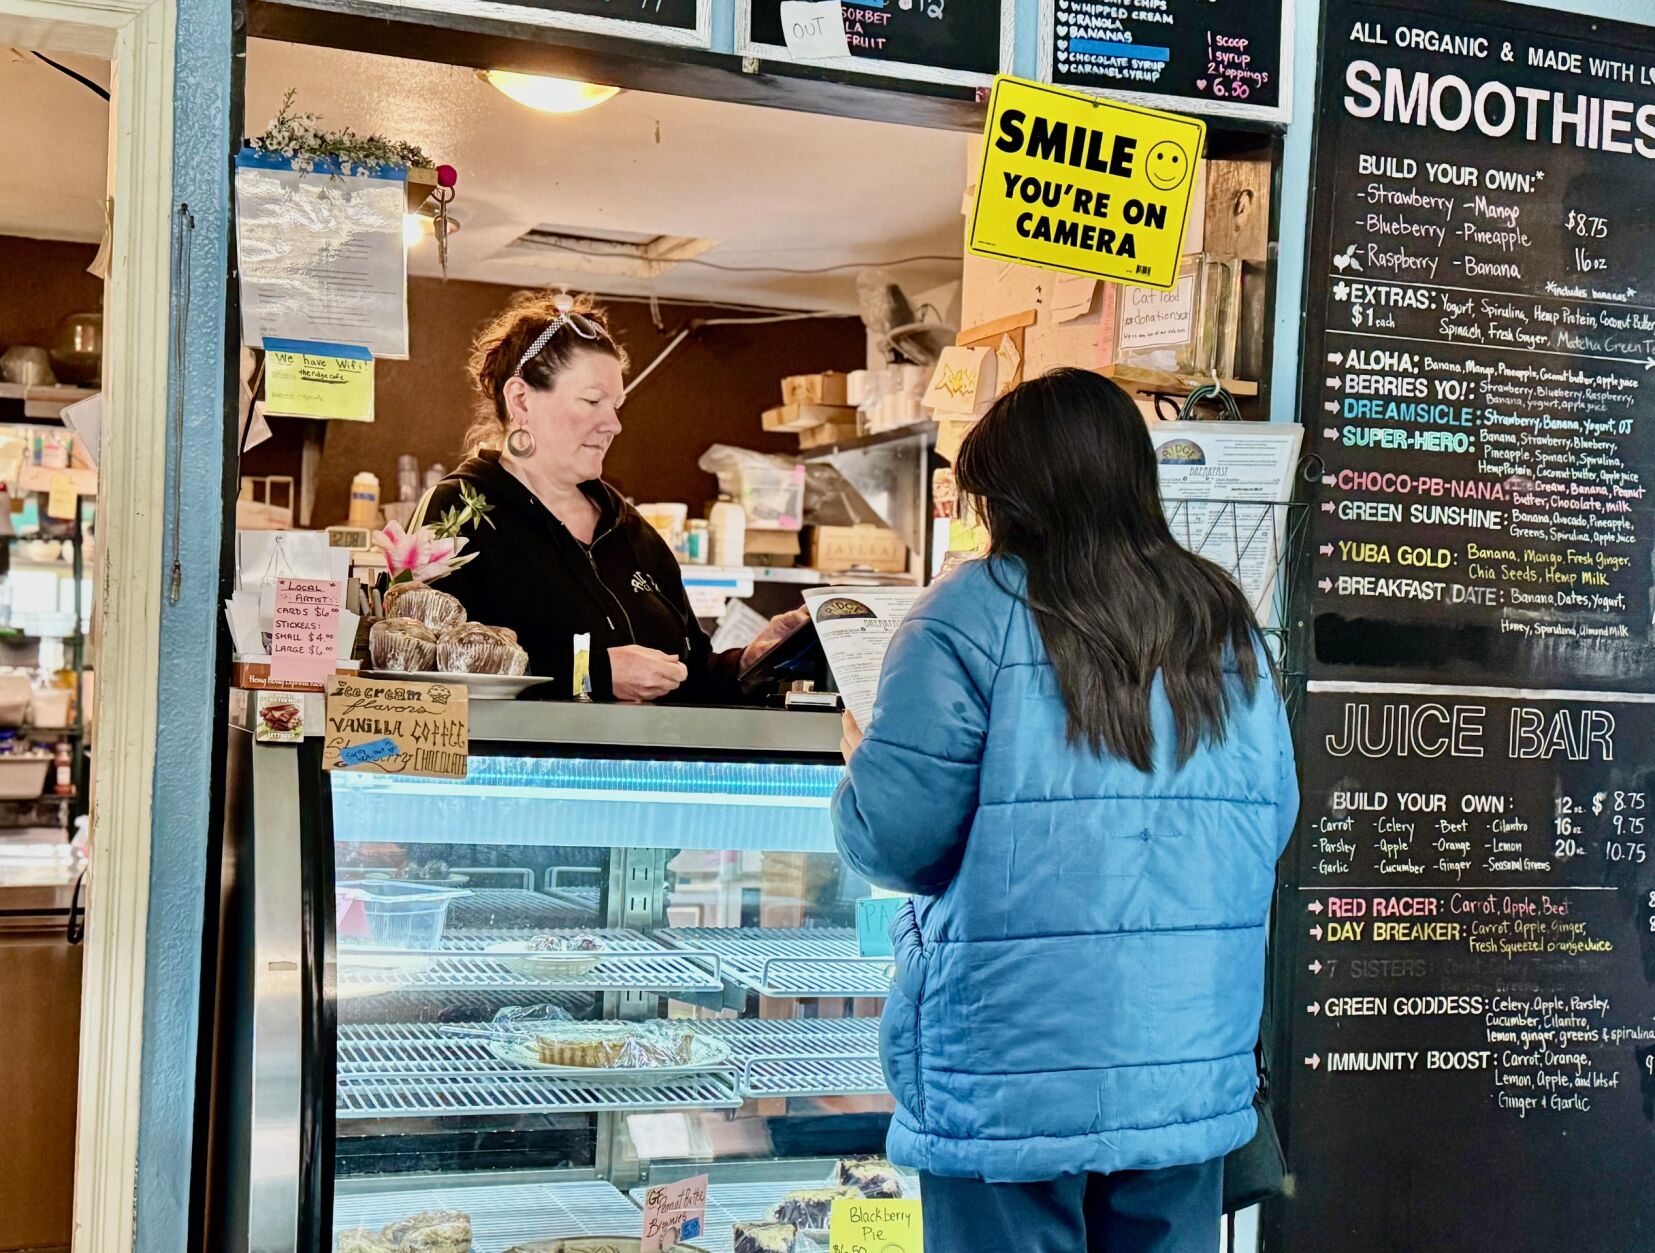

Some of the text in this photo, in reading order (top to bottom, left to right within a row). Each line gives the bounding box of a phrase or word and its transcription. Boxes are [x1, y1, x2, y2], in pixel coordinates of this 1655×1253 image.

[841, 7, 892, 26] SORBET
[1069, 13, 1123, 30] GRANOLA
[1071, 2, 1128, 19] WHIPPED
[1132, 11, 1174, 25] CREAM
[792, 17, 825, 39] OUT
[1069, 25, 1133, 43] BANANAS
[846, 34, 887, 49] FRUIT
[1216, 34, 1249, 50] scoop
[1350, 22, 1633, 83] ALL ORGANIC & MADE WITH
[1069, 52, 1165, 72] CHOCOLATE SYRUP
[1215, 51, 1250, 66] syrup
[1070, 63, 1160, 83] CARAMEL SYRUP
[1219, 63, 1269, 88] toppings
[1213, 78, 1250, 99] 6.50
[1344, 60, 1655, 159] SMOOTHIES
[995, 109, 1137, 178] SMILE
[1359, 154, 1477, 187] BUILD YOUR
[1003, 172, 1167, 230] YOU'RE ON
[1016, 212, 1136, 259] CAMERA
[1565, 210, 1608, 239] $8.75
[1557, 332, 1601, 350] Matcha
[1604, 337, 1641, 353] Green
[275, 353, 294, 364] We
[303, 354, 326, 367] have
[1345, 349, 1419, 374] ALOHA:
[1344, 374, 1428, 398] BERRIES
[1344, 398, 1481, 427] DREAMSICLE:
[1343, 426, 1475, 453] SUPER-HERO:
[1338, 501, 1402, 522] GREEN
[1410, 504, 1508, 530] SUNSHINE:
[1338, 540, 1593, 568] YUBA GOLD: Fresh
[288, 581, 322, 592] LOCAL
[1469, 563, 1496, 580] Chia
[1501, 564, 1542, 584] Seeds,
[1545, 567, 1577, 588] Hemp
[1338, 576, 1446, 600] BREAKFAST
[1451, 583, 1504, 606] DATE:
[277, 607, 308, 616] CARDS
[275, 633, 301, 641] SMALL
[275, 645, 304, 654] LARGE
[364, 687, 422, 701] cream
[340, 698, 446, 715] flavors
[411, 719, 466, 749] COFFEE
[1325, 703, 1615, 760] JUICE BAR
[414, 748, 468, 775] CHOCOLATE
[1333, 791, 1513, 813] BUILD YOUR OWN:
[1554, 815, 1645, 835] 16 9.75
[1555, 839, 1646, 863] 20 10.75
[1328, 897, 1366, 917] RED
[1373, 897, 1444, 917] RACER:
[1542, 895, 1573, 915] Beet
[1328, 921, 1365, 941] DAY
[1373, 921, 1467, 941] BREAKER:
[1469, 936, 1544, 960] Fresh Squeezed
[1325, 996, 1489, 1016] GREEN GODDESS:
[1486, 1014, 1541, 1029] Cucumber,
[1559, 1029, 1599, 1048] greens
[1611, 1026, 1655, 1045] spirulina
[1327, 1051, 1419, 1071] IMMUNITY
[1427, 1051, 1498, 1070] BOOST:
[1494, 1069, 1591, 1089] Lemon, and
[1498, 1091, 1590, 1118] Ginger Garlic
[850, 1206, 910, 1228] Blackberry
[862, 1227, 887, 1240] Pie
